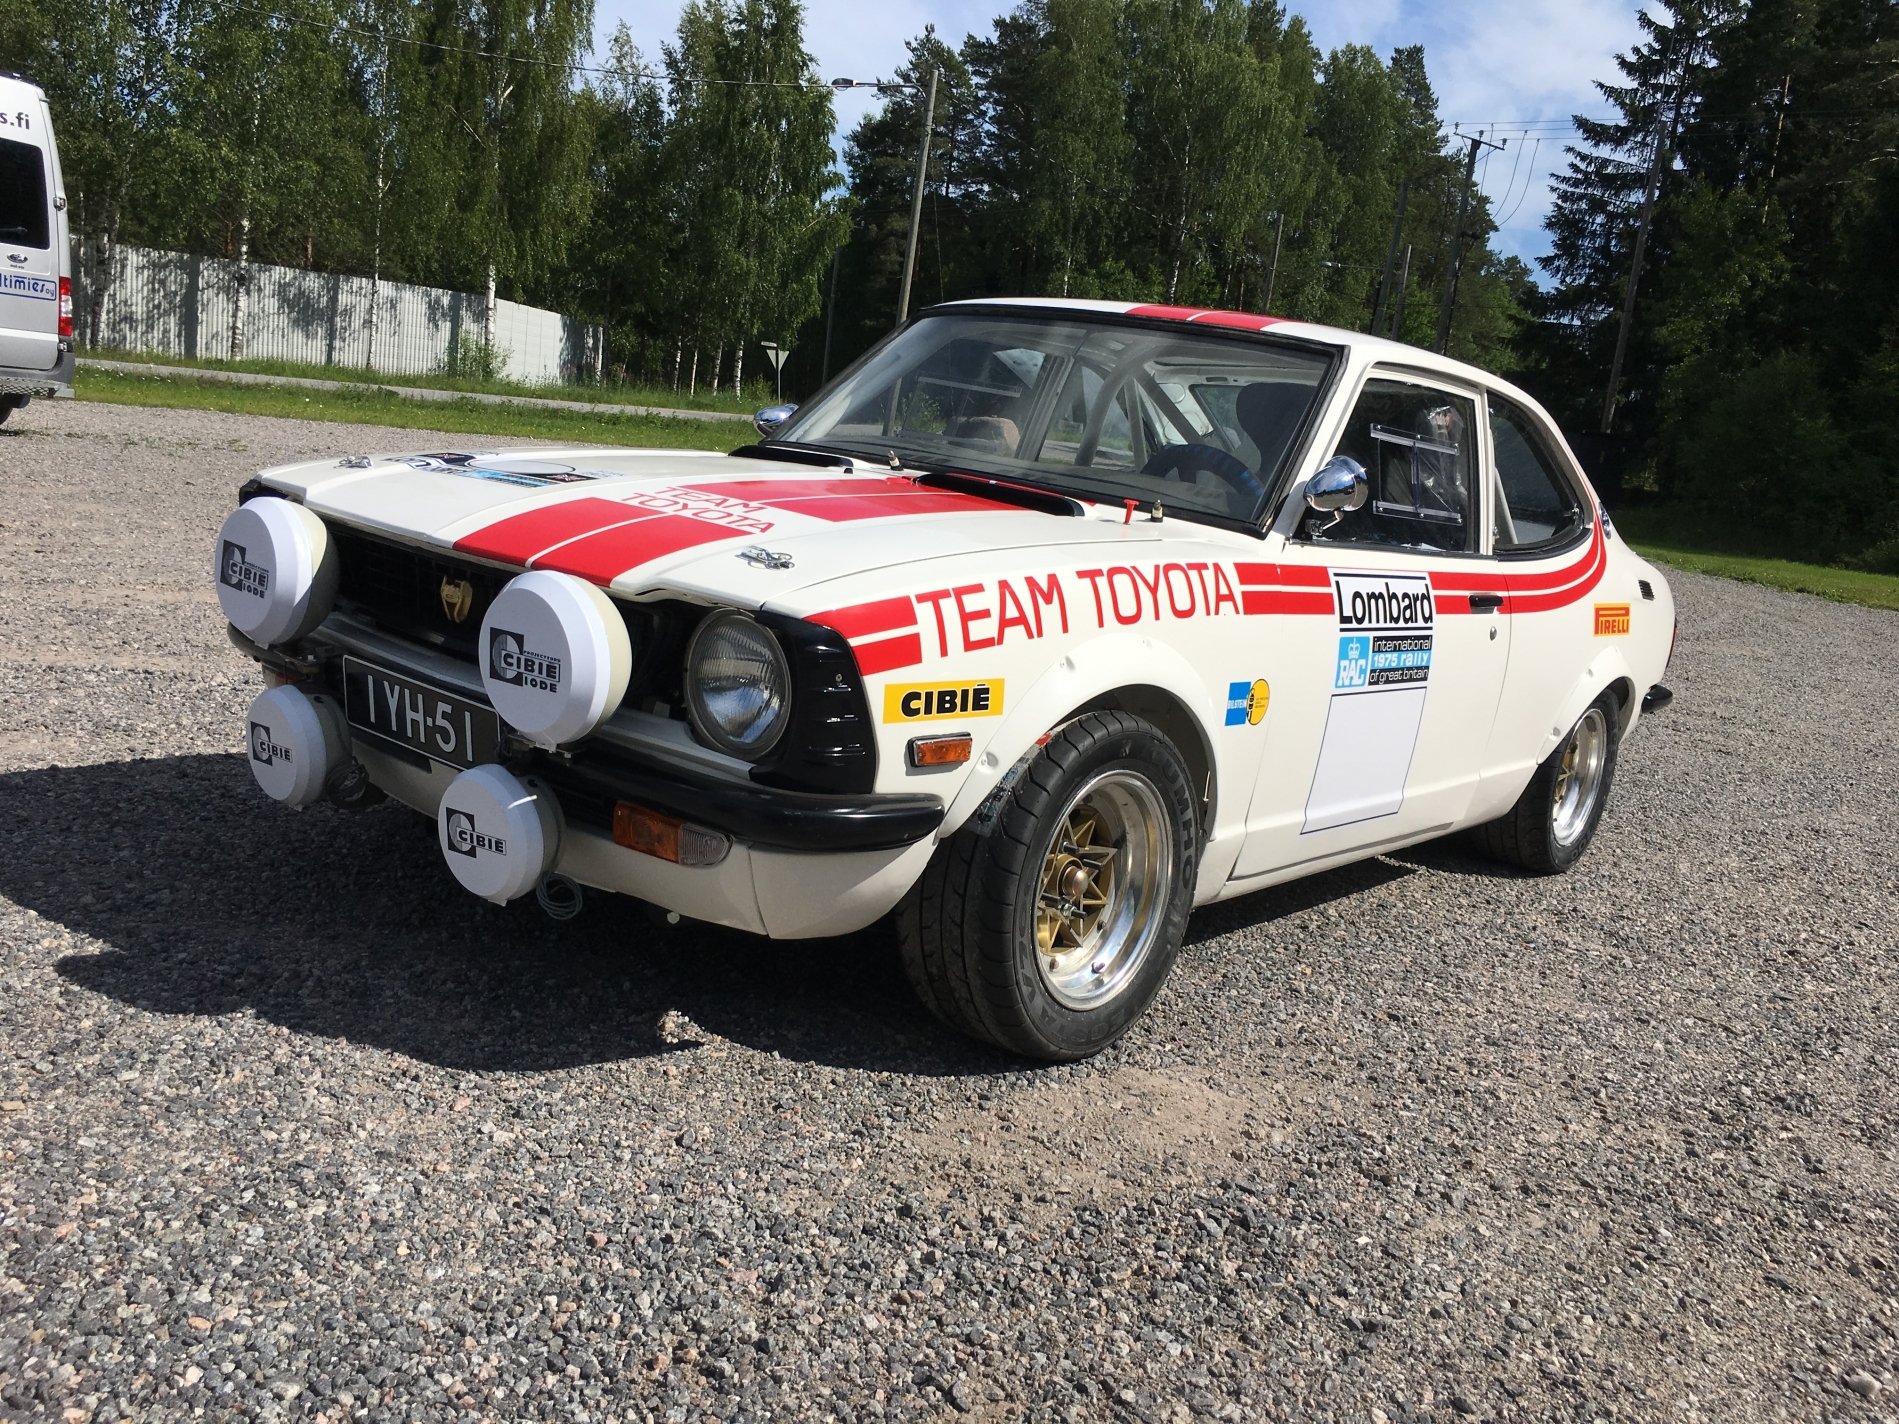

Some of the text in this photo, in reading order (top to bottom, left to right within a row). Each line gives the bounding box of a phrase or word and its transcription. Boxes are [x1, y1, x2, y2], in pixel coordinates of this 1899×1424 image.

[621, 492, 776, 533] TOYOTA
[655, 486, 768, 514] TEAM
[230, 561, 267, 588] CIBIE
[242, 582, 265, 599] IODE
[1334, 580, 1433, 625] Lombard
[914, 561, 1241, 658] TEAM TOYOTA
[1594, 606, 1630, 635] PIRELLI
[1374, 636, 1431, 652] international
[502, 652, 558, 680] CIBIE
[1336, 658, 1367, 687] RAC
[1373, 652, 1430, 668] 1975 rally
[524, 675, 558, 694] IODE
[1369, 666, 1428, 685] of great britain
[367, 674, 474, 762] IYH-51
[259, 741, 291, 760] CIBIE
[1149, 752, 1193, 890] UMHO
[458, 829, 505, 854] CIBIE
